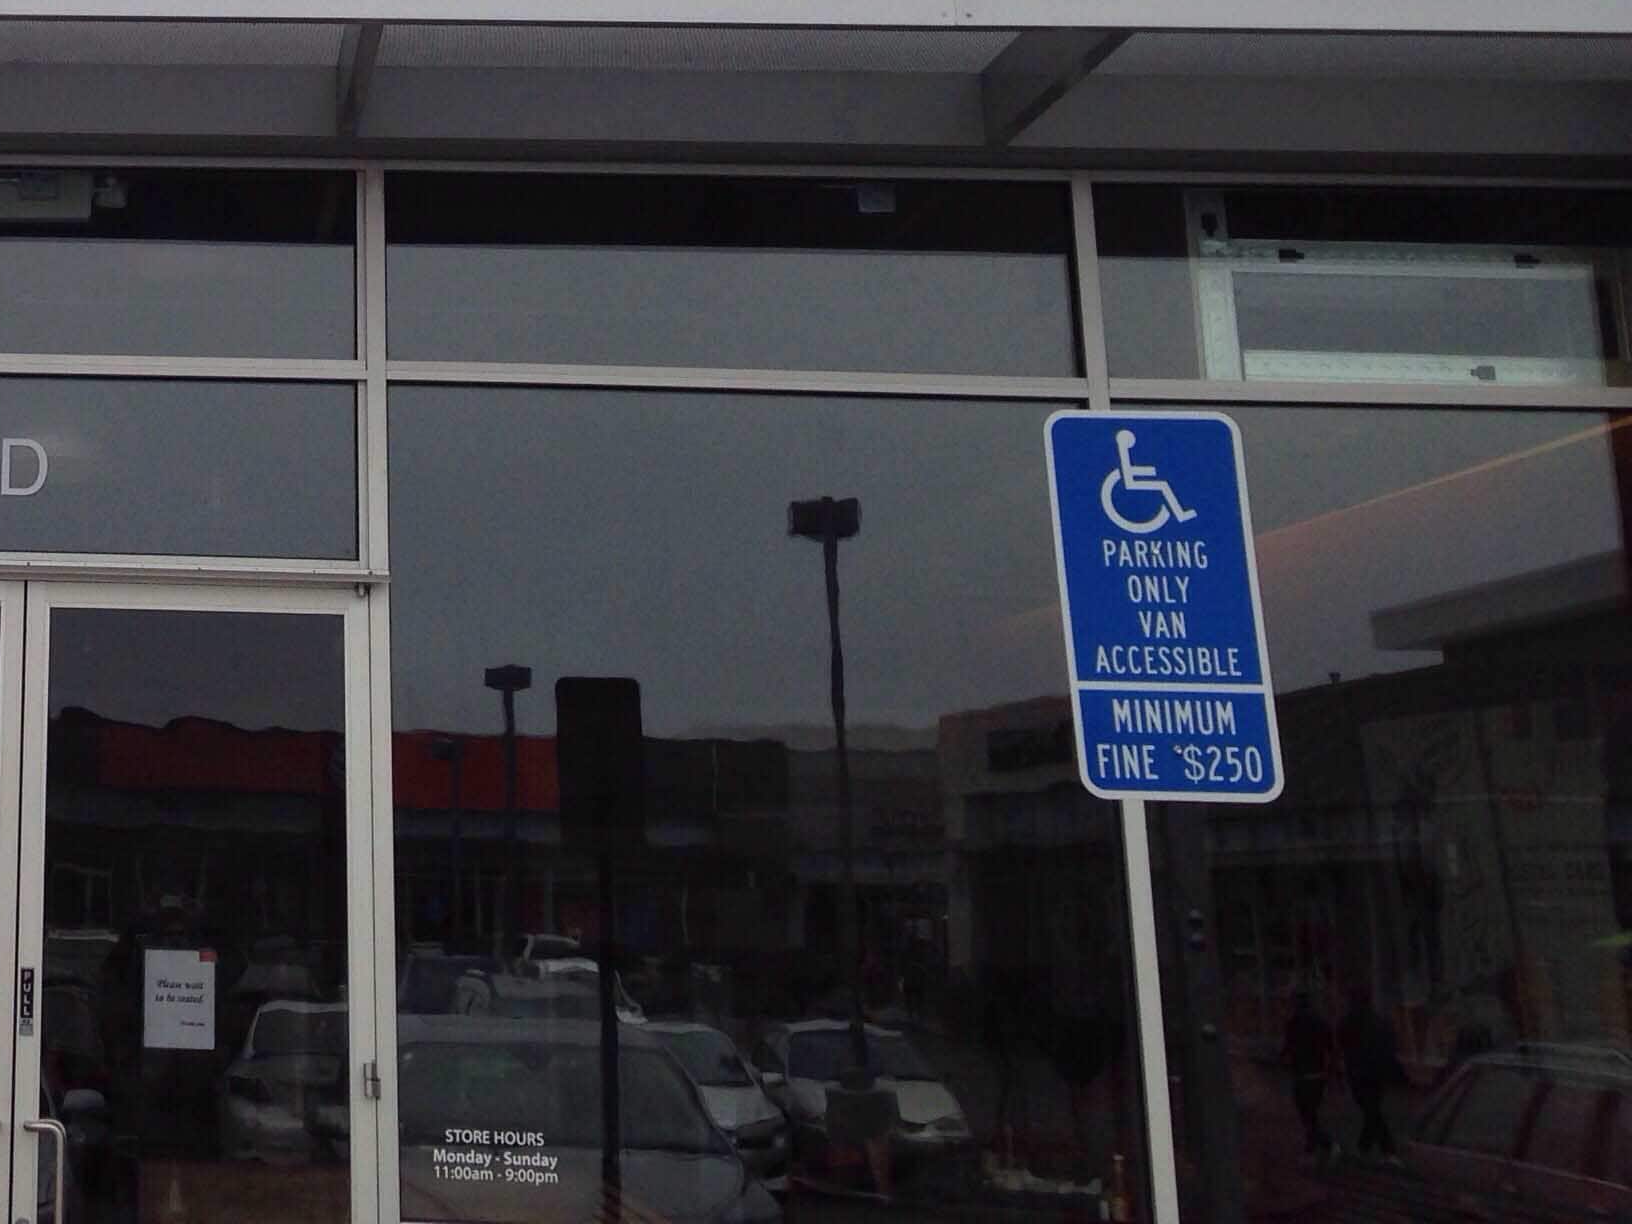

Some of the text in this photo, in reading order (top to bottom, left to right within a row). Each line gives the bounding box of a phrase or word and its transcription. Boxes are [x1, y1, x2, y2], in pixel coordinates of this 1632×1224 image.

[1, 438, 48, 495] D
[1103, 539, 1208, 569] PARKING
[1128, 575, 1190, 604] ONLY
[1138, 611, 1186, 639] VAN
[1096, 646, 1242, 677] ACCESSIBLE
[1112, 698, 1237, 736] MINIMUM
[1096, 744, 1263, 784] FINE $250
[23, 970, 32, 1016] PULL
[445, 1129, 545, 1146] STORE HOURS
[433, 1149, 492, 1167] Monday
[504, 1151, 558, 1170] Sunday
[433, 1166, 494, 1181] 11:00am
[505, 1169, 559, 1186] 9:00pm
